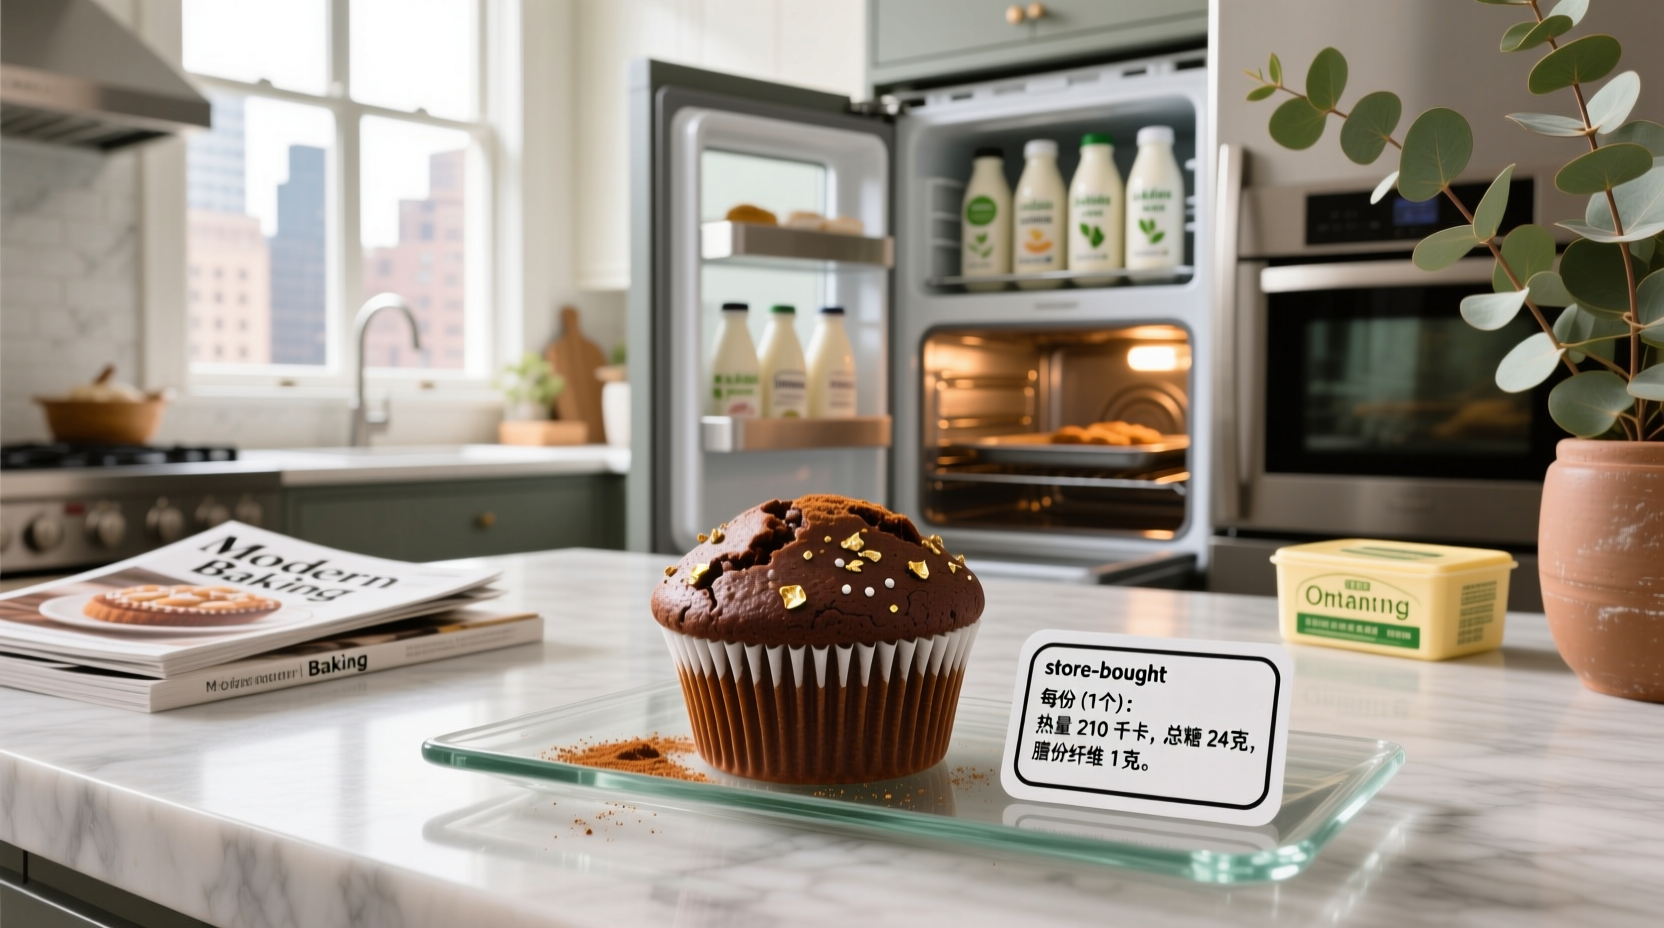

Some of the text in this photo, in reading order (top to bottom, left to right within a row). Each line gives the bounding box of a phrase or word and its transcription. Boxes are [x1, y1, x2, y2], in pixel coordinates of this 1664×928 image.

[198, 536, 399, 588] Modern
[190, 560, 356, 602] Baking
[308, 654, 368, 677] Baking
[1044, 659, 1168, 687] store-bought
[1040, 687, 1077, 710] 每份
[1035, 713, 1072, 736] 热量
[1077, 719, 1109, 738] 210
